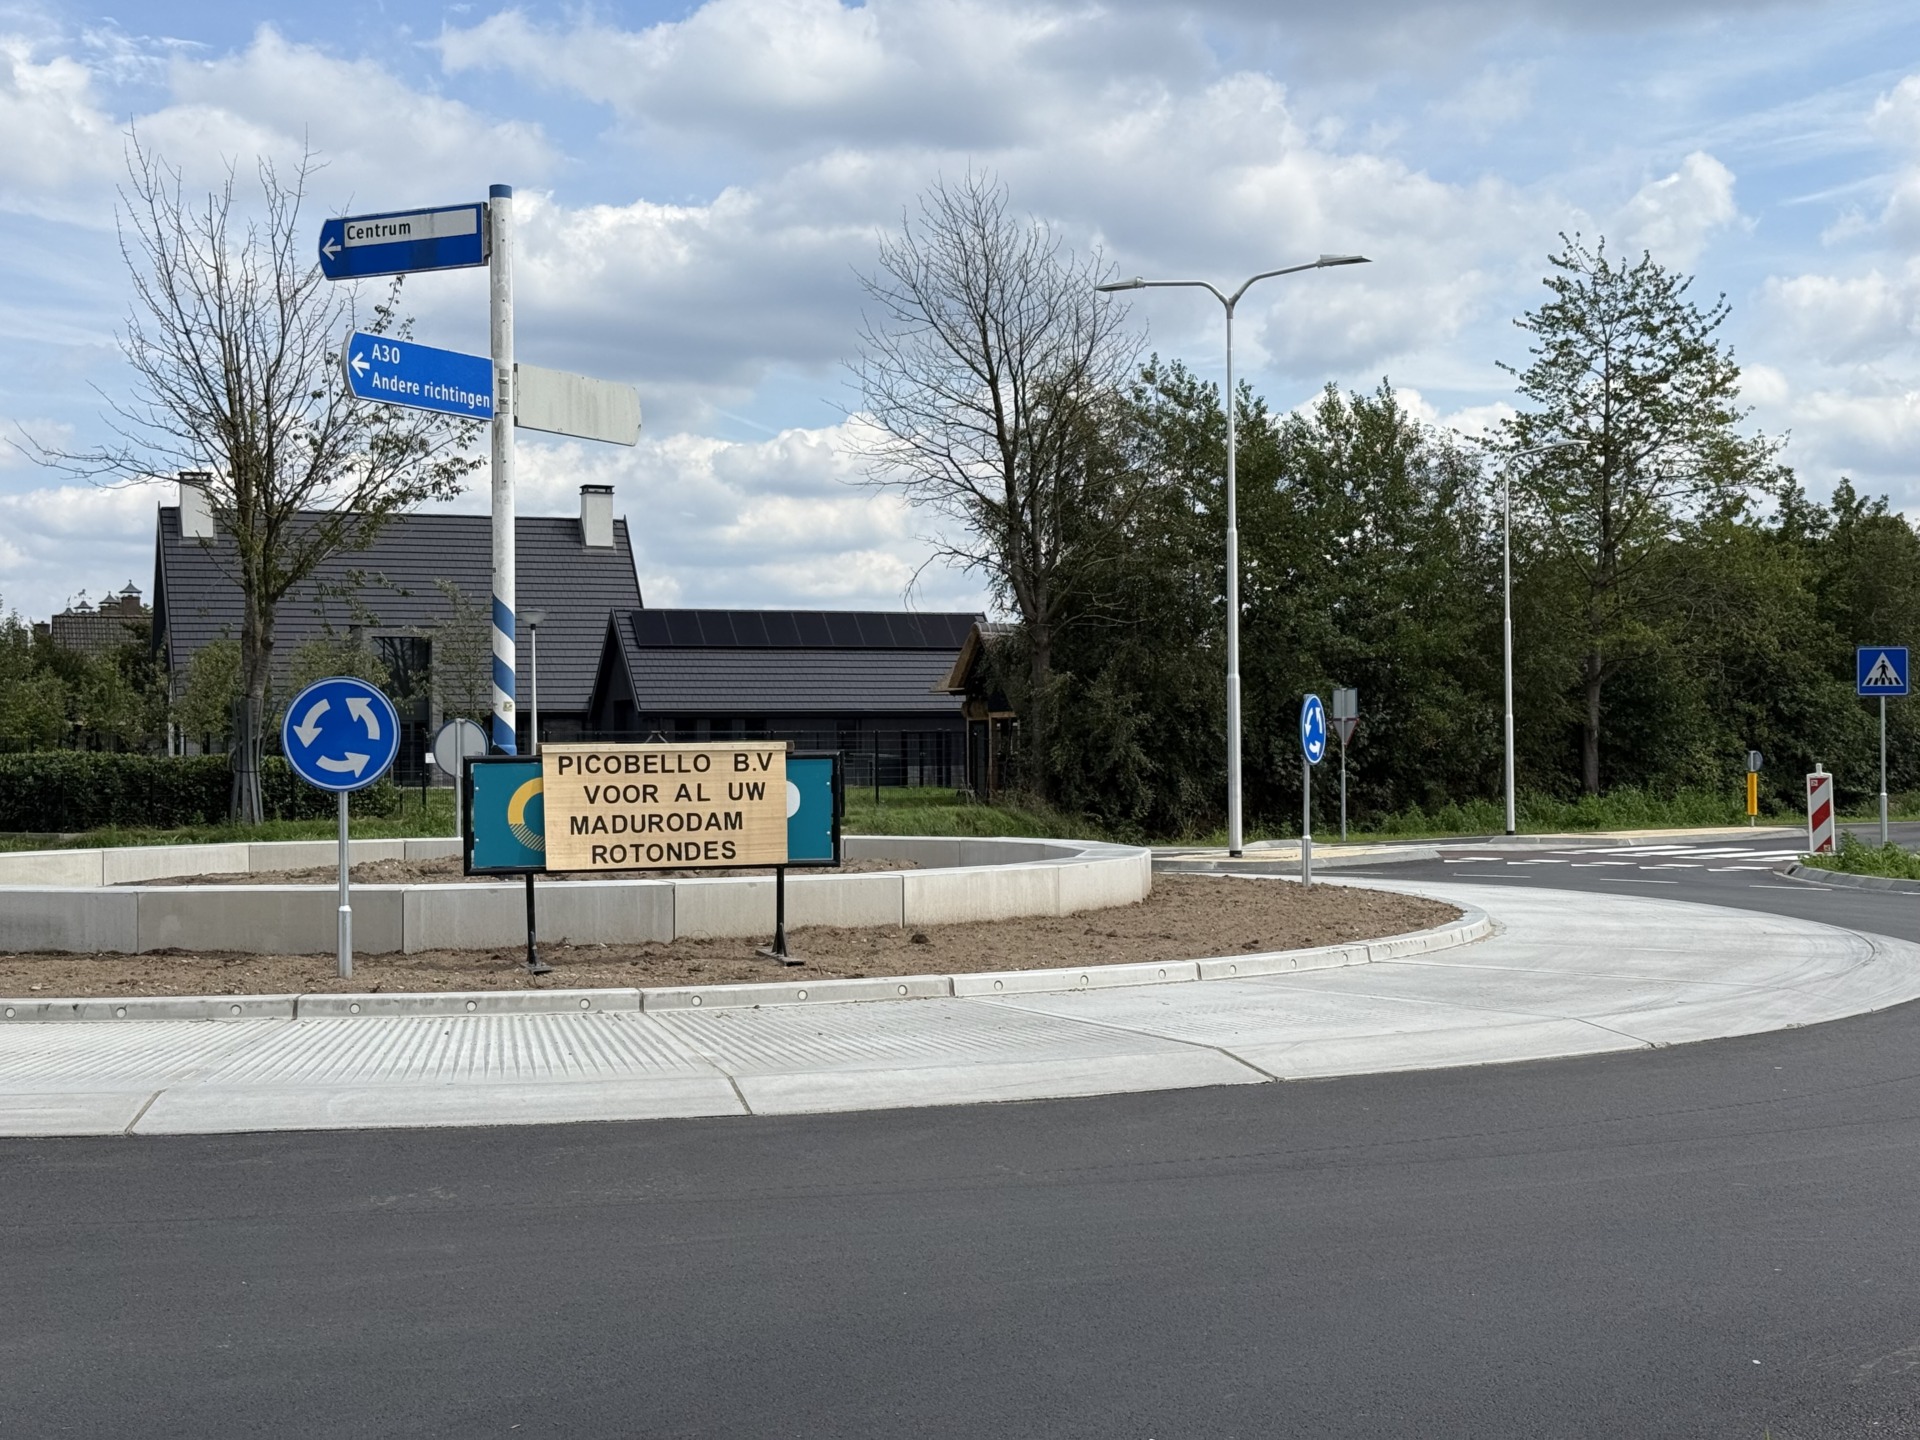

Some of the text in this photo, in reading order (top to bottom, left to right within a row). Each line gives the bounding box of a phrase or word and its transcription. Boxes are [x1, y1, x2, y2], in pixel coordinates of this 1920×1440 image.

[346, 222, 411, 240] Centrum
[371, 343, 401, 364] A30
[371, 371, 490, 410] Andere richtingen
[558, 751, 774, 776] PICOBELLO B.V
[583, 781, 766, 805] VOOR AL UW
[570, 811, 743, 836] MADURODAM
[591, 840, 737, 865] ROTONDES
